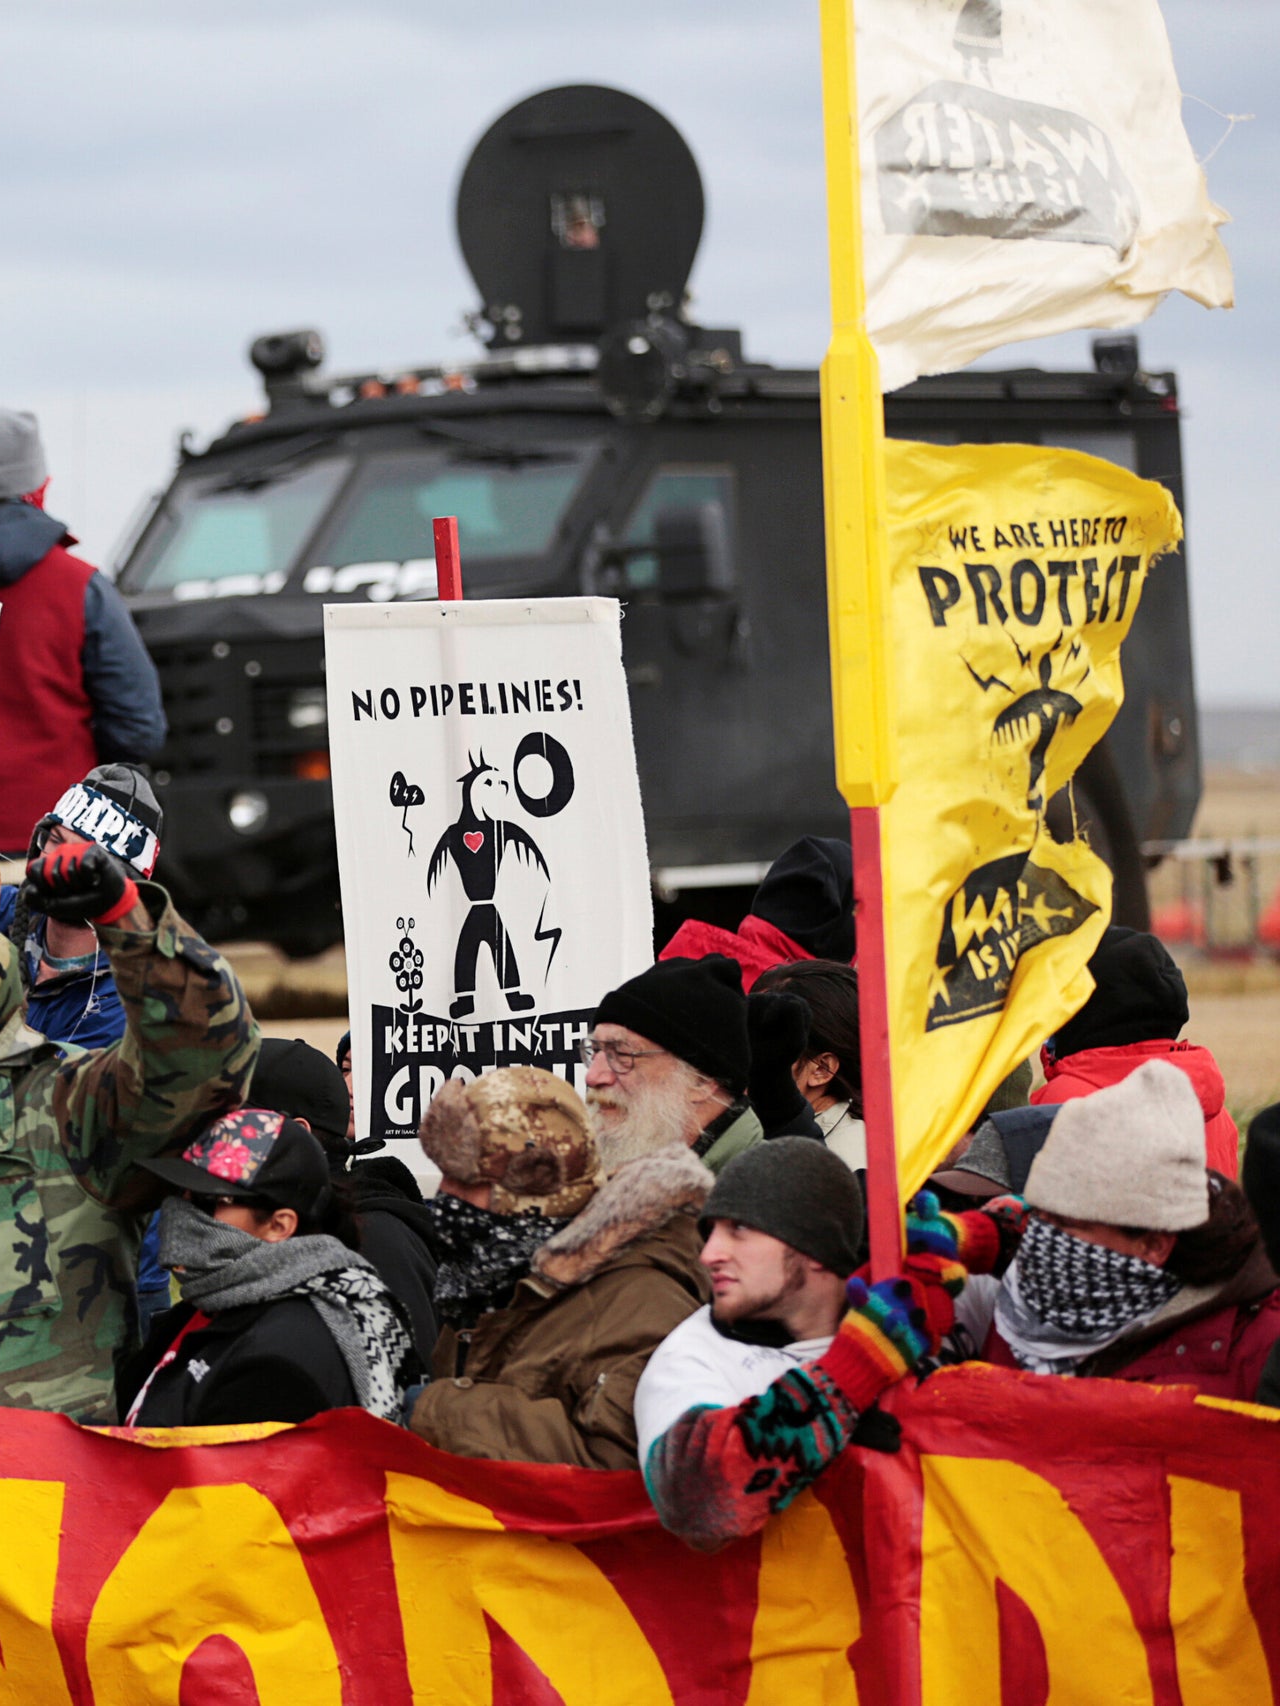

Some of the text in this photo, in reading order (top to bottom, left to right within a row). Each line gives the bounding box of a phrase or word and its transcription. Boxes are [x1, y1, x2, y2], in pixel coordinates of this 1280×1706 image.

[949, 516, 1127, 552] WE ARE HERE TO
[917, 555, 1141, 627] PROTECT
[351, 679, 583, 721] NO PIPELINES!
[967, 944, 1000, 981] IS
[384, 1022, 588, 1054] KEEP IT IN TH
